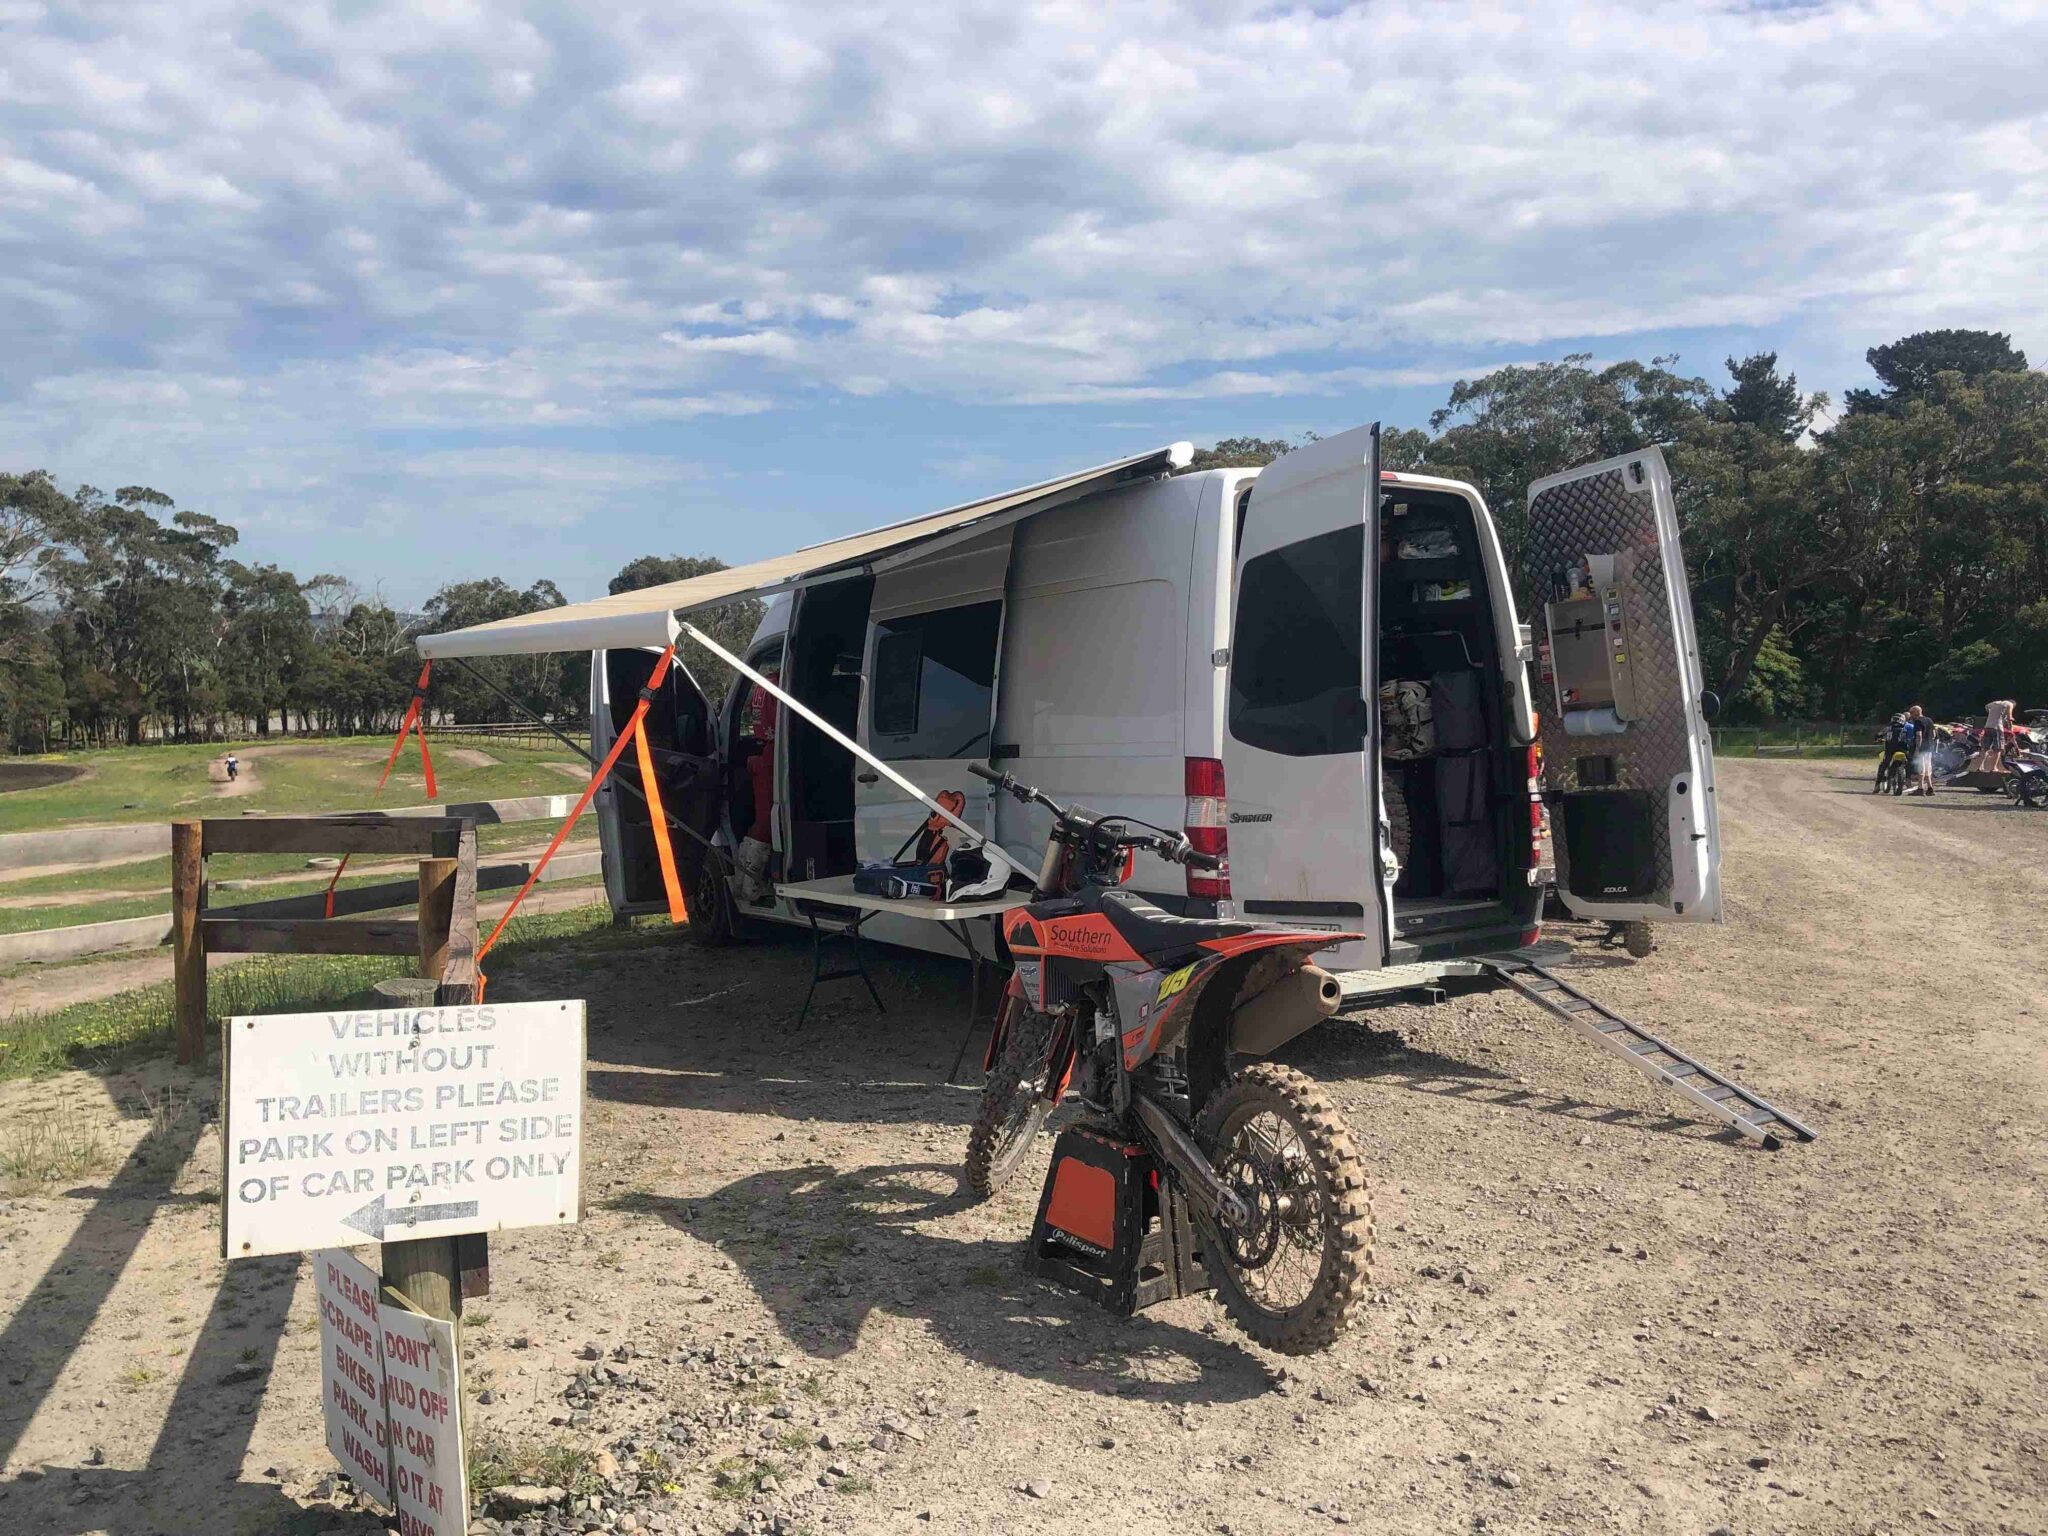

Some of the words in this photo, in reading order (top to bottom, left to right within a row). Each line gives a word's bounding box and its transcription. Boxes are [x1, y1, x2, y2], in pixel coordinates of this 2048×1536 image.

[1050, 924, 1112, 945] Southern
[328, 1006, 497, 1039] VEHICLES
[329, 1044, 495, 1079] WITHOUT
[255, 1087, 424, 1122] TRAILERS
[435, 1077, 559, 1110] PLEASE
[238, 1132, 335, 1164] PARK
[345, 1127, 398, 1155] ON
[410, 1120, 489, 1149] LEFT
[499, 1114, 572, 1142] SIDE
[238, 1175, 289, 1204] OF
[301, 1168, 374, 1198] CAR
[387, 1159, 475, 1190] PARK
[485, 1150, 571, 1181] ONLY
[320, 1293, 372, 1359] SCRAPE
[336, 1344, 376, 1400] BIKES
[385, 1330, 430, 1372] DON'T
[333, 1379, 372, 1438] PARK.
[419, 1387, 448, 1424] OFF
[342, 1425, 385, 1488] WASH
[406, 1426, 435, 1466] CAR
[428, 1482, 443, 1515] AT
